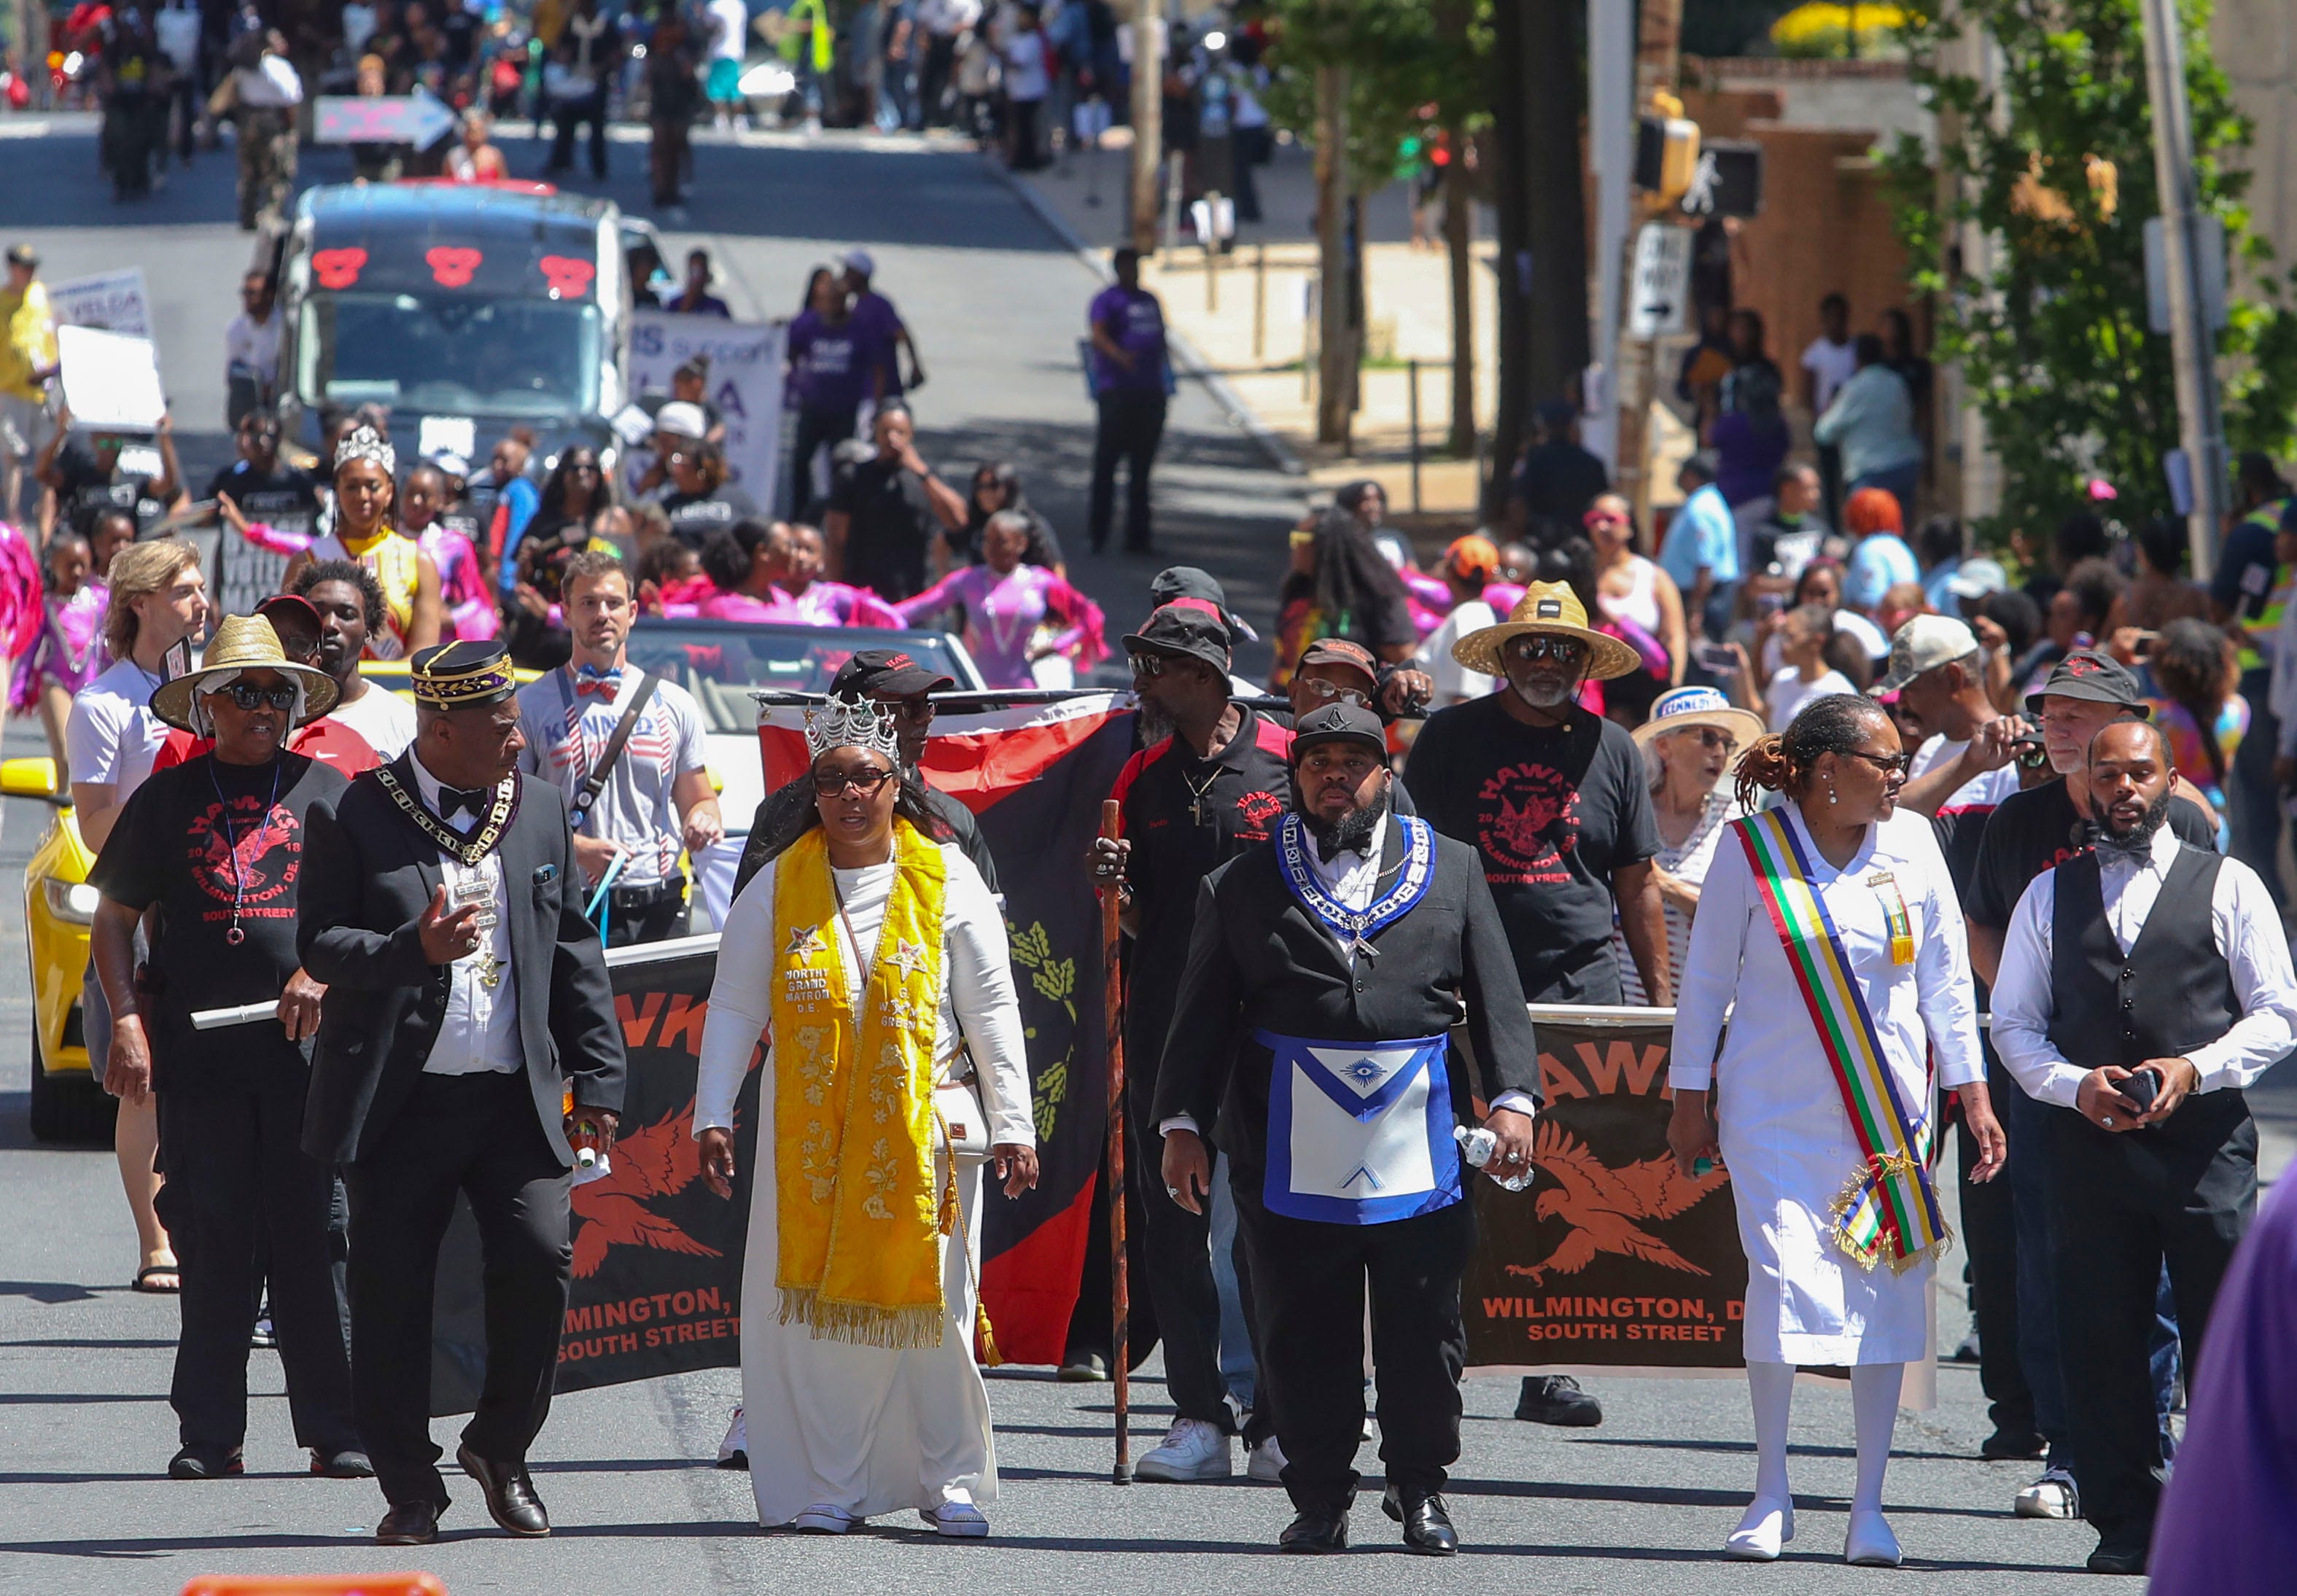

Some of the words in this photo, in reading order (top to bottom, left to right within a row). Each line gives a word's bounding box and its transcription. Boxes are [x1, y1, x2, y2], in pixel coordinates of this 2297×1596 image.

[1237, 791, 1282, 813] HAWKS
[187, 795, 300, 835] HAWKS
[187, 847, 203, 858] 20
[284, 842, 301, 852] 18
[785, 968, 829, 981] WORTHY
[788, 978, 827, 992] GRAND
[785, 989, 829, 1003] MATRON
[1482, 1297, 1715, 1323] WILMINGTON,
[645, 1317, 741, 1348] STREET
[1528, 1323, 1617, 1341] SOUTH
[1626, 1324, 1727, 1342] STREET
